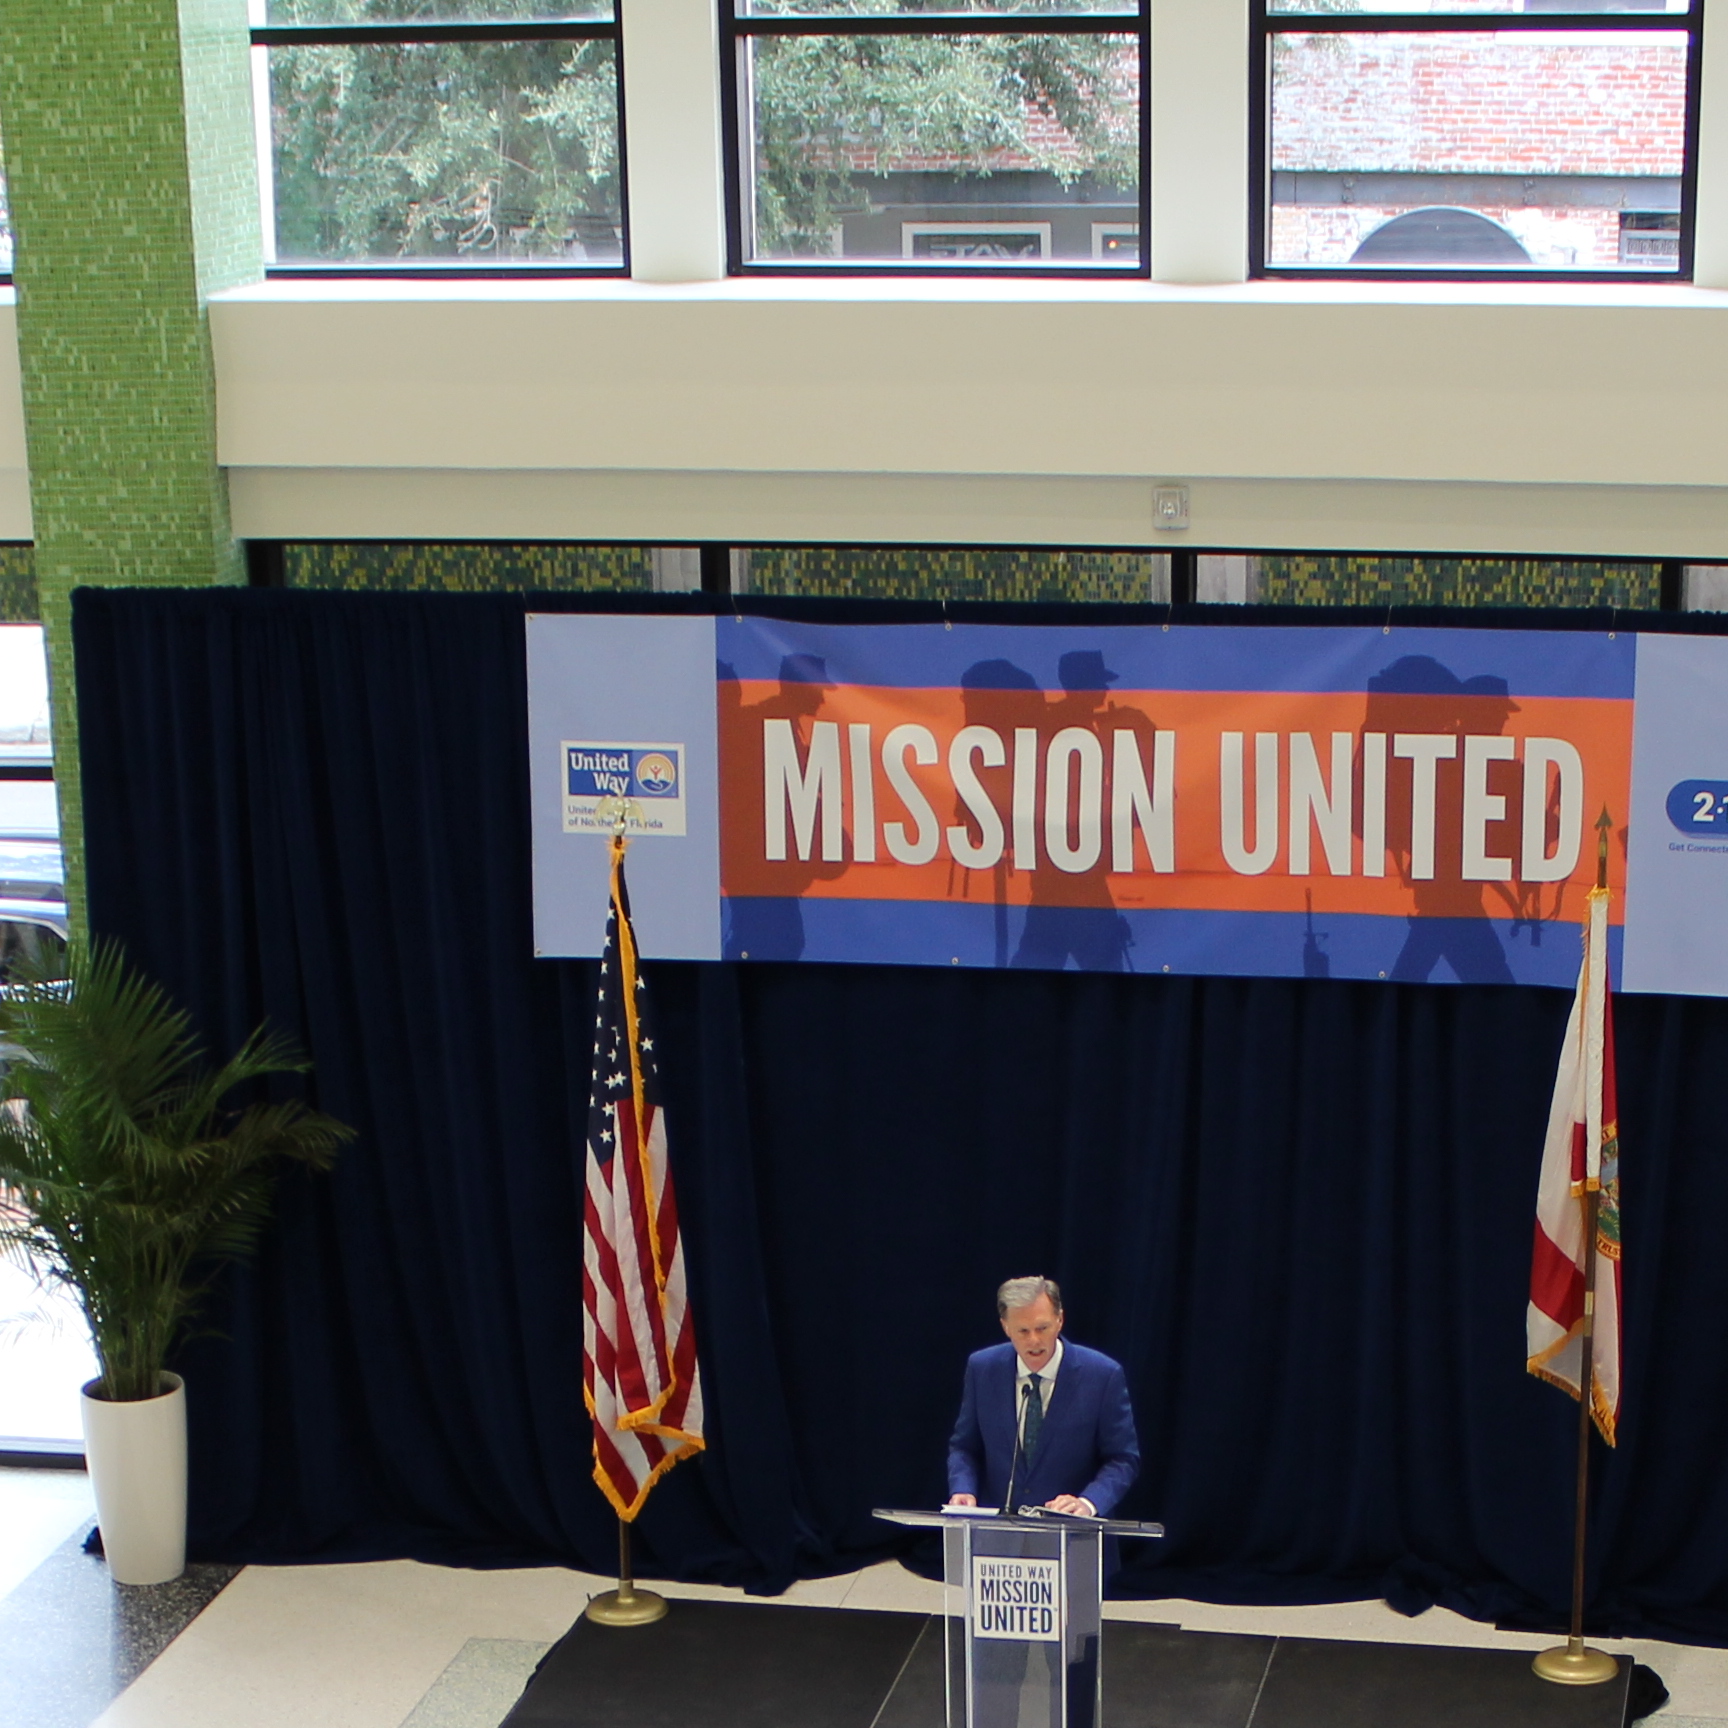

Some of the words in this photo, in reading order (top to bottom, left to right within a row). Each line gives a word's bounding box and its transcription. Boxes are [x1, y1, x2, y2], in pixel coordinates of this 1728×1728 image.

[570, 752, 630, 772] United
[593, 772, 630, 797] Way
[568, 805, 598, 816] Unite
[764, 718, 1175, 873] MISSION
[1220, 731, 1585, 883] UNITED
[568, 818, 578, 827] of
[1669, 842, 1685, 852] Get
[980, 1564, 1022, 1579] UNITED
[1027, 1566, 1052, 1580] WAY
[980, 1579, 1052, 1605] MISSION
[980, 1604, 1053, 1634] UNITED
